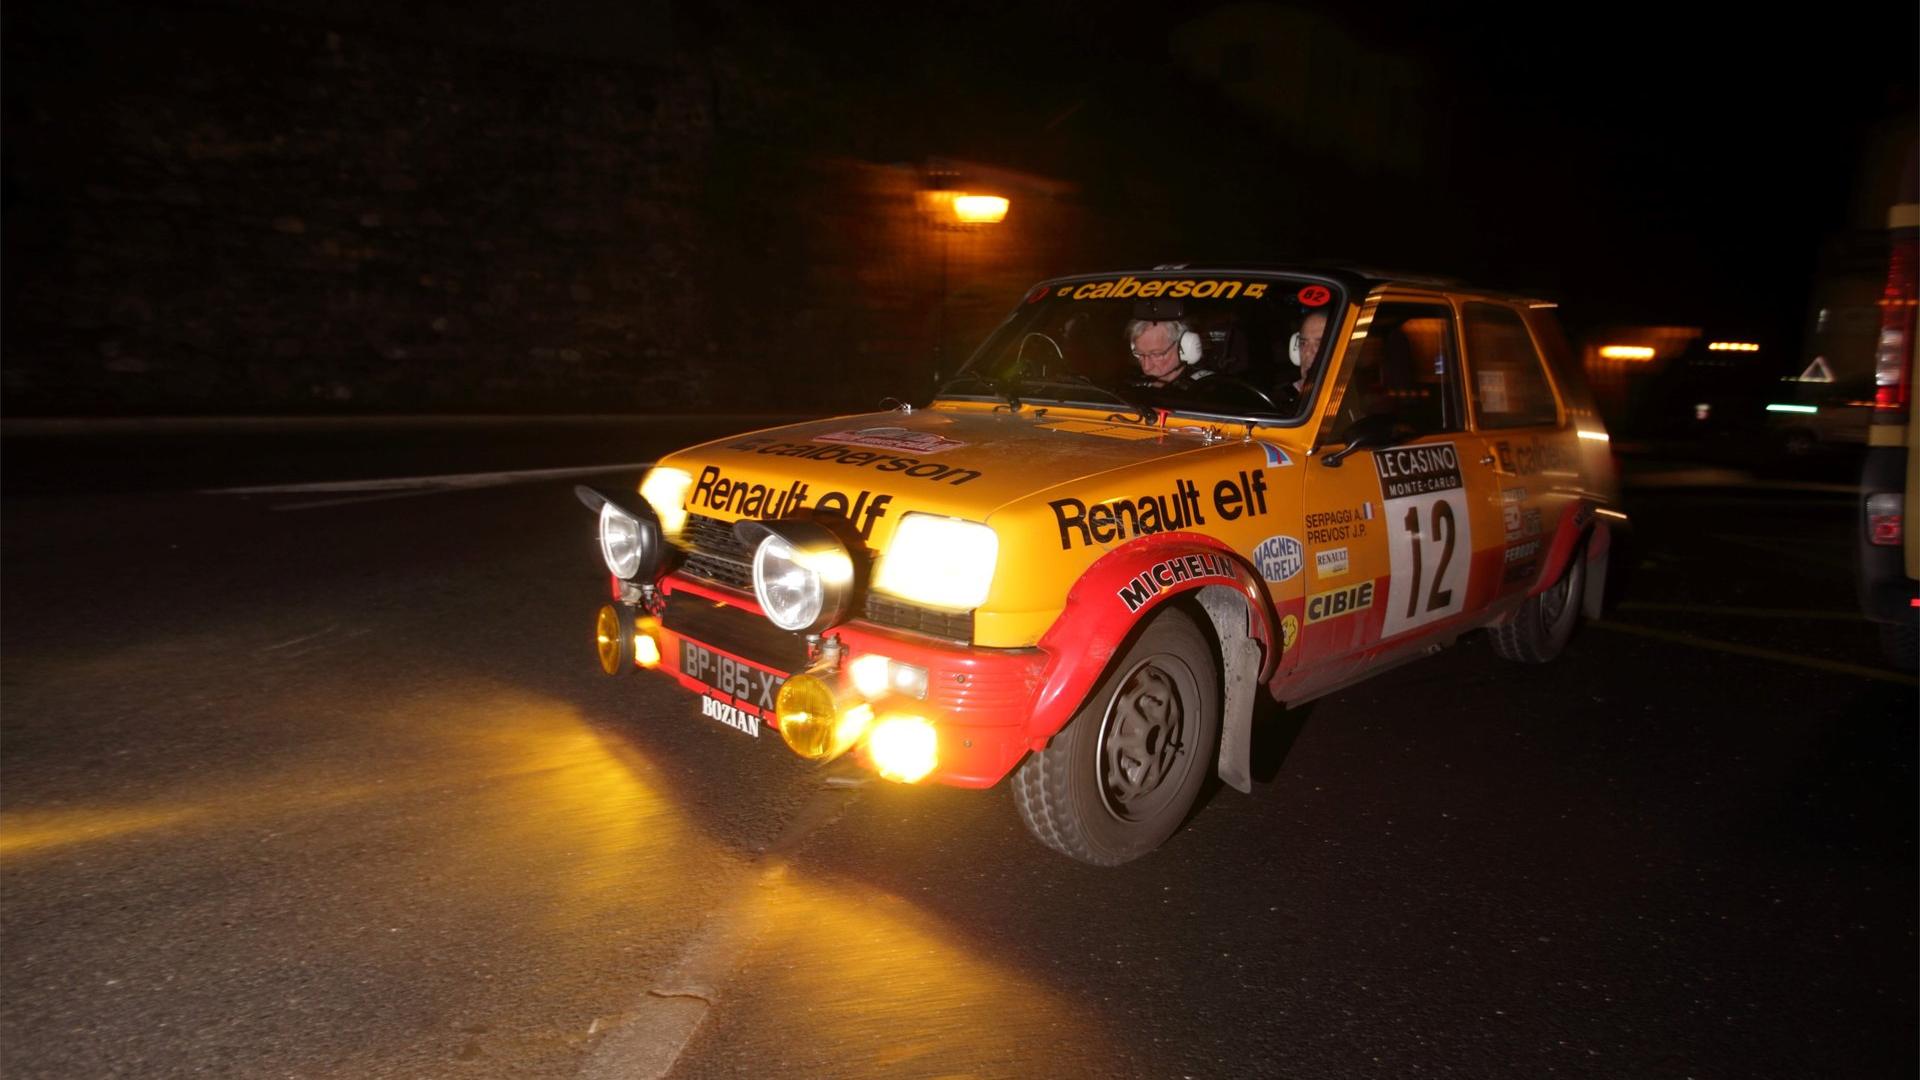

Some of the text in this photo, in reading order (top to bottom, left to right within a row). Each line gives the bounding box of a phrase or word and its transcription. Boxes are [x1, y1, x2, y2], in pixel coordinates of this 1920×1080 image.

[1073, 277, 1243, 299] calberson
[757, 443, 982, 486] calberson
[1376, 447, 1455, 478] LE CASINO
[1389, 476, 1457, 497] MONTE-CARLO
[1048, 469, 1267, 550] Renault elf
[1305, 510, 1353, 528] SERPAGGI
[1307, 526, 1350, 544] PREVOST
[1317, 550, 1347, 566] RENAULT
[1404, 500, 1456, 619] 12
[1117, 554, 1236, 613] MICHELIN
[702, 695, 760, 738] BOZIAN
